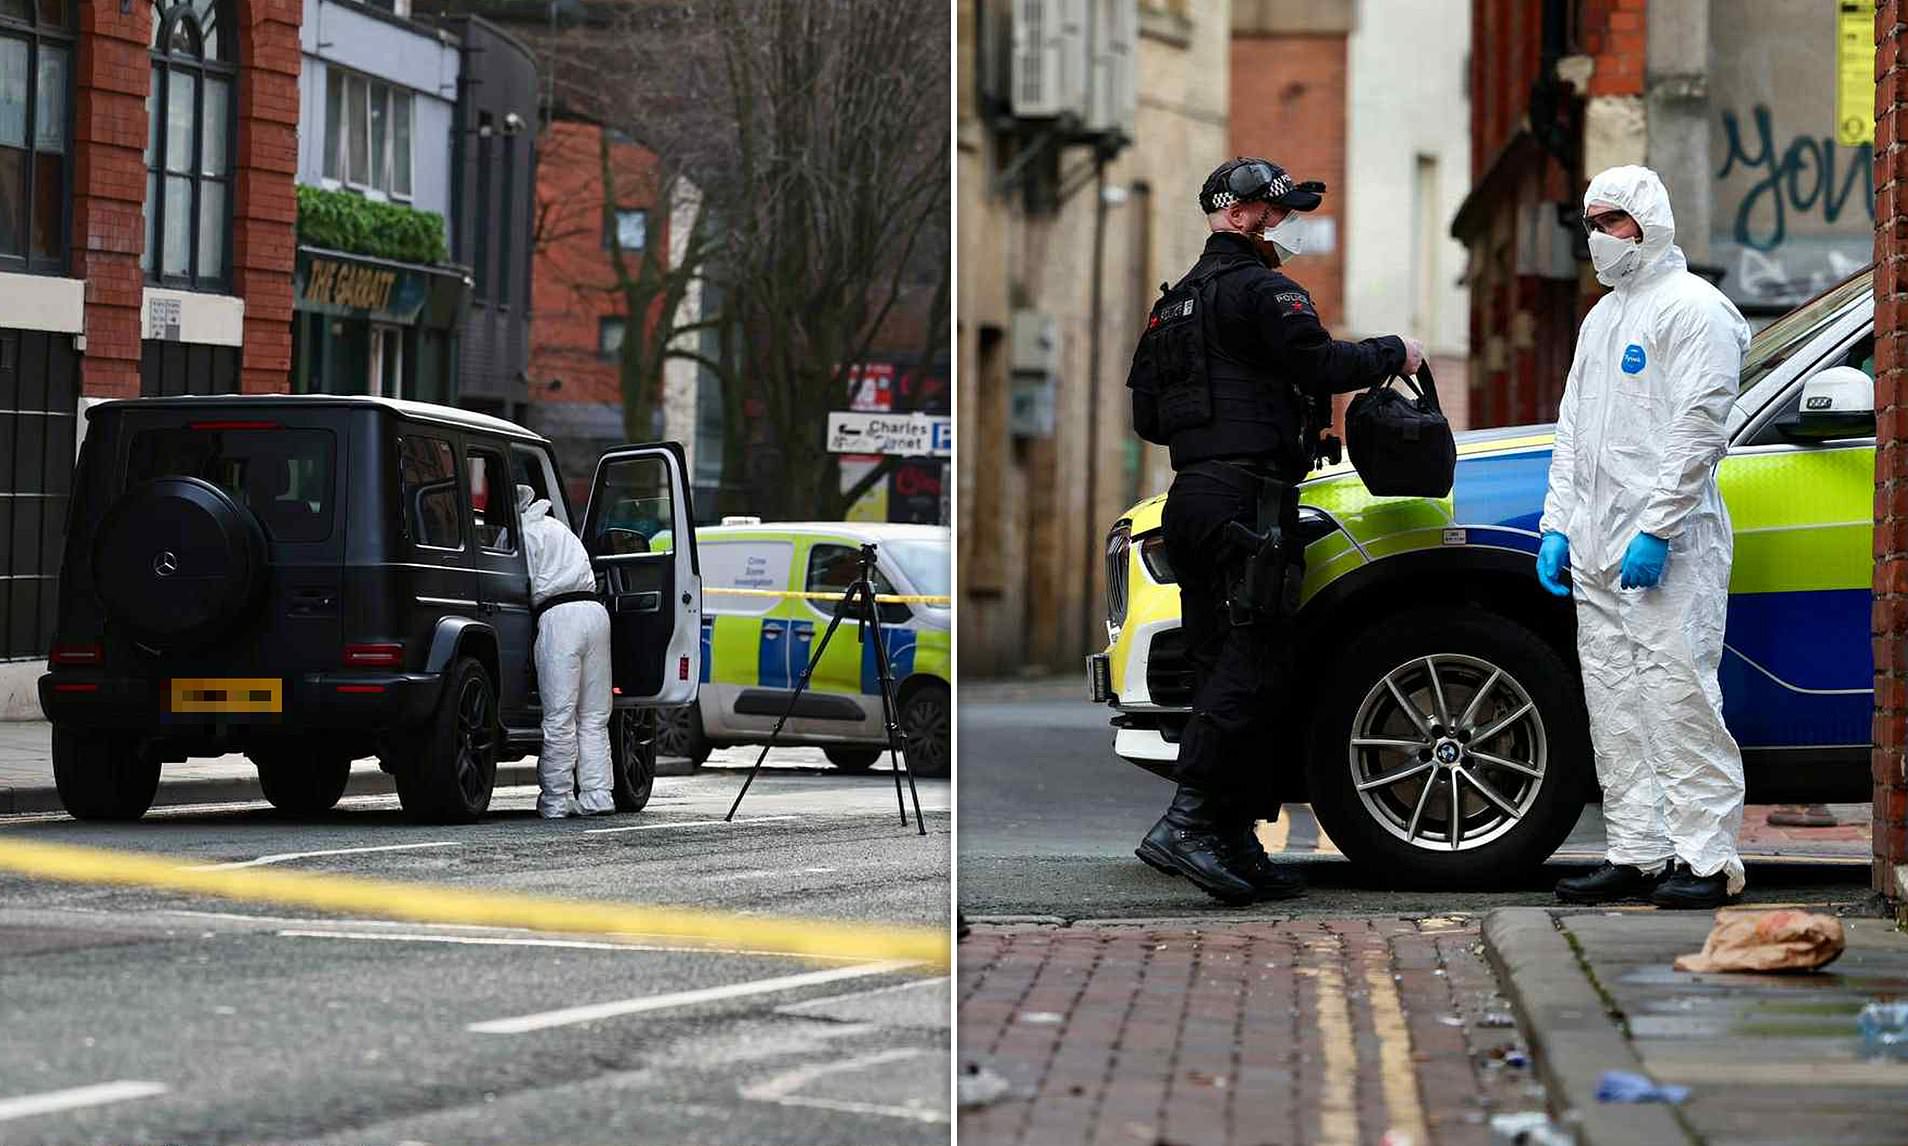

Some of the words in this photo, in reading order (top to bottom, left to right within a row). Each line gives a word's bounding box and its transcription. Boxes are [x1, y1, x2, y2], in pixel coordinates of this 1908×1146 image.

[307, 259, 337, 302] THE
[335, 263, 395, 310] GARRATT
[869, 420, 928, 436] Charles
[748, 556, 767, 565] Crime
